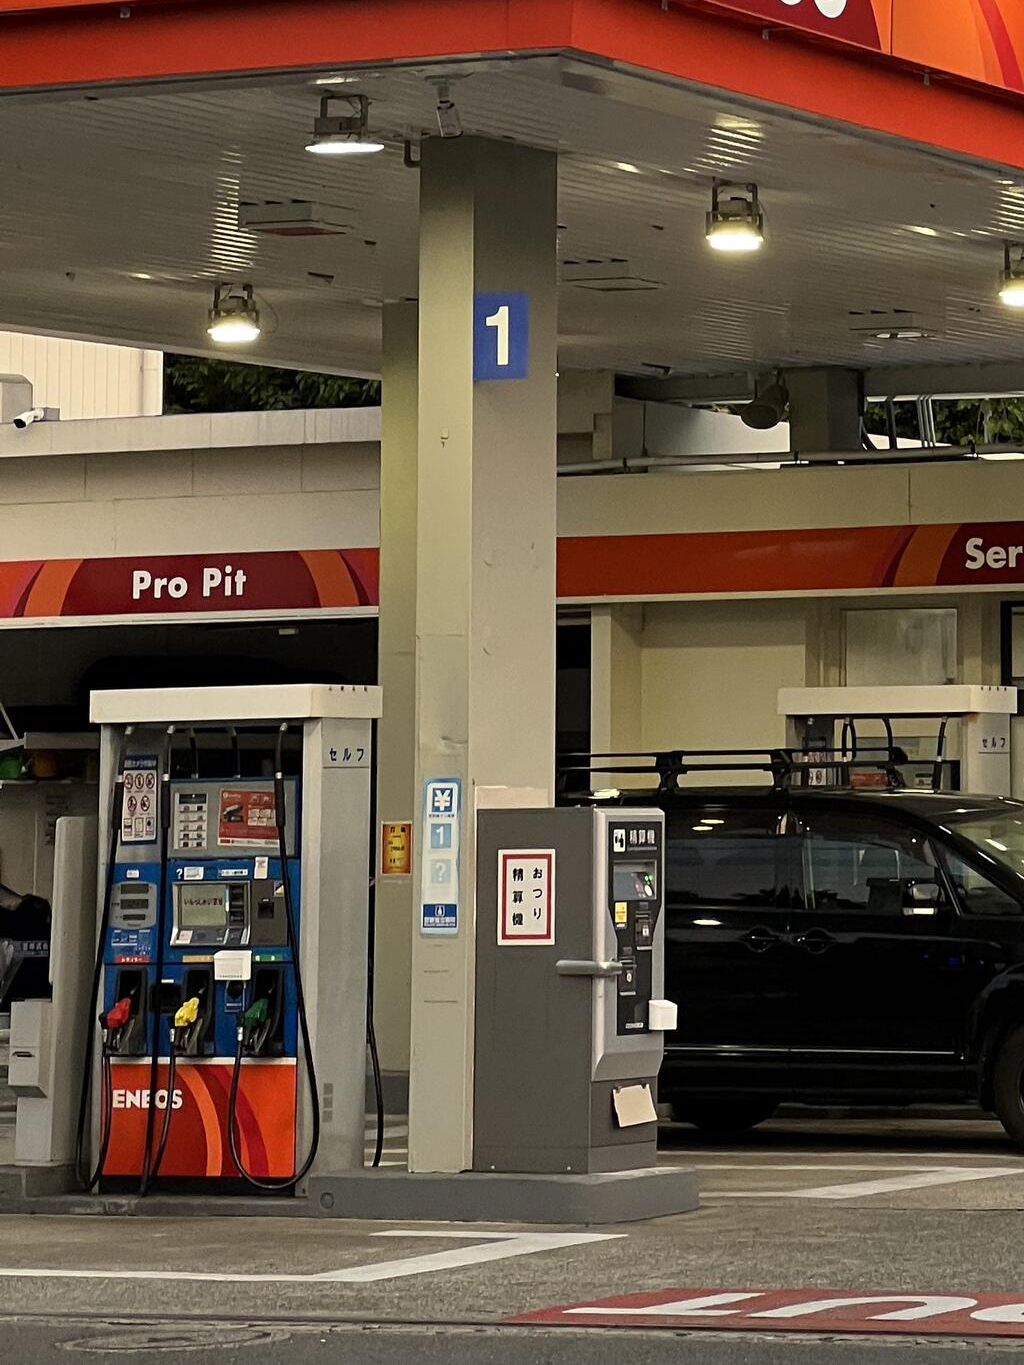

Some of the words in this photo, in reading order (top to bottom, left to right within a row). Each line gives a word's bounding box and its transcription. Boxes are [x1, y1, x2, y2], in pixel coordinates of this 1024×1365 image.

[485, 305, 509, 366] 1
[132, 570, 188, 599] Pro
[203, 565, 247, 597] Pit
[982, 737, 1007, 749] セルフ
[329, 747, 365, 762] セルフ
[436, 826, 444, 845] 1
[532, 867, 543, 920] おつり
[112, 1089, 183, 1109] ENEOS
